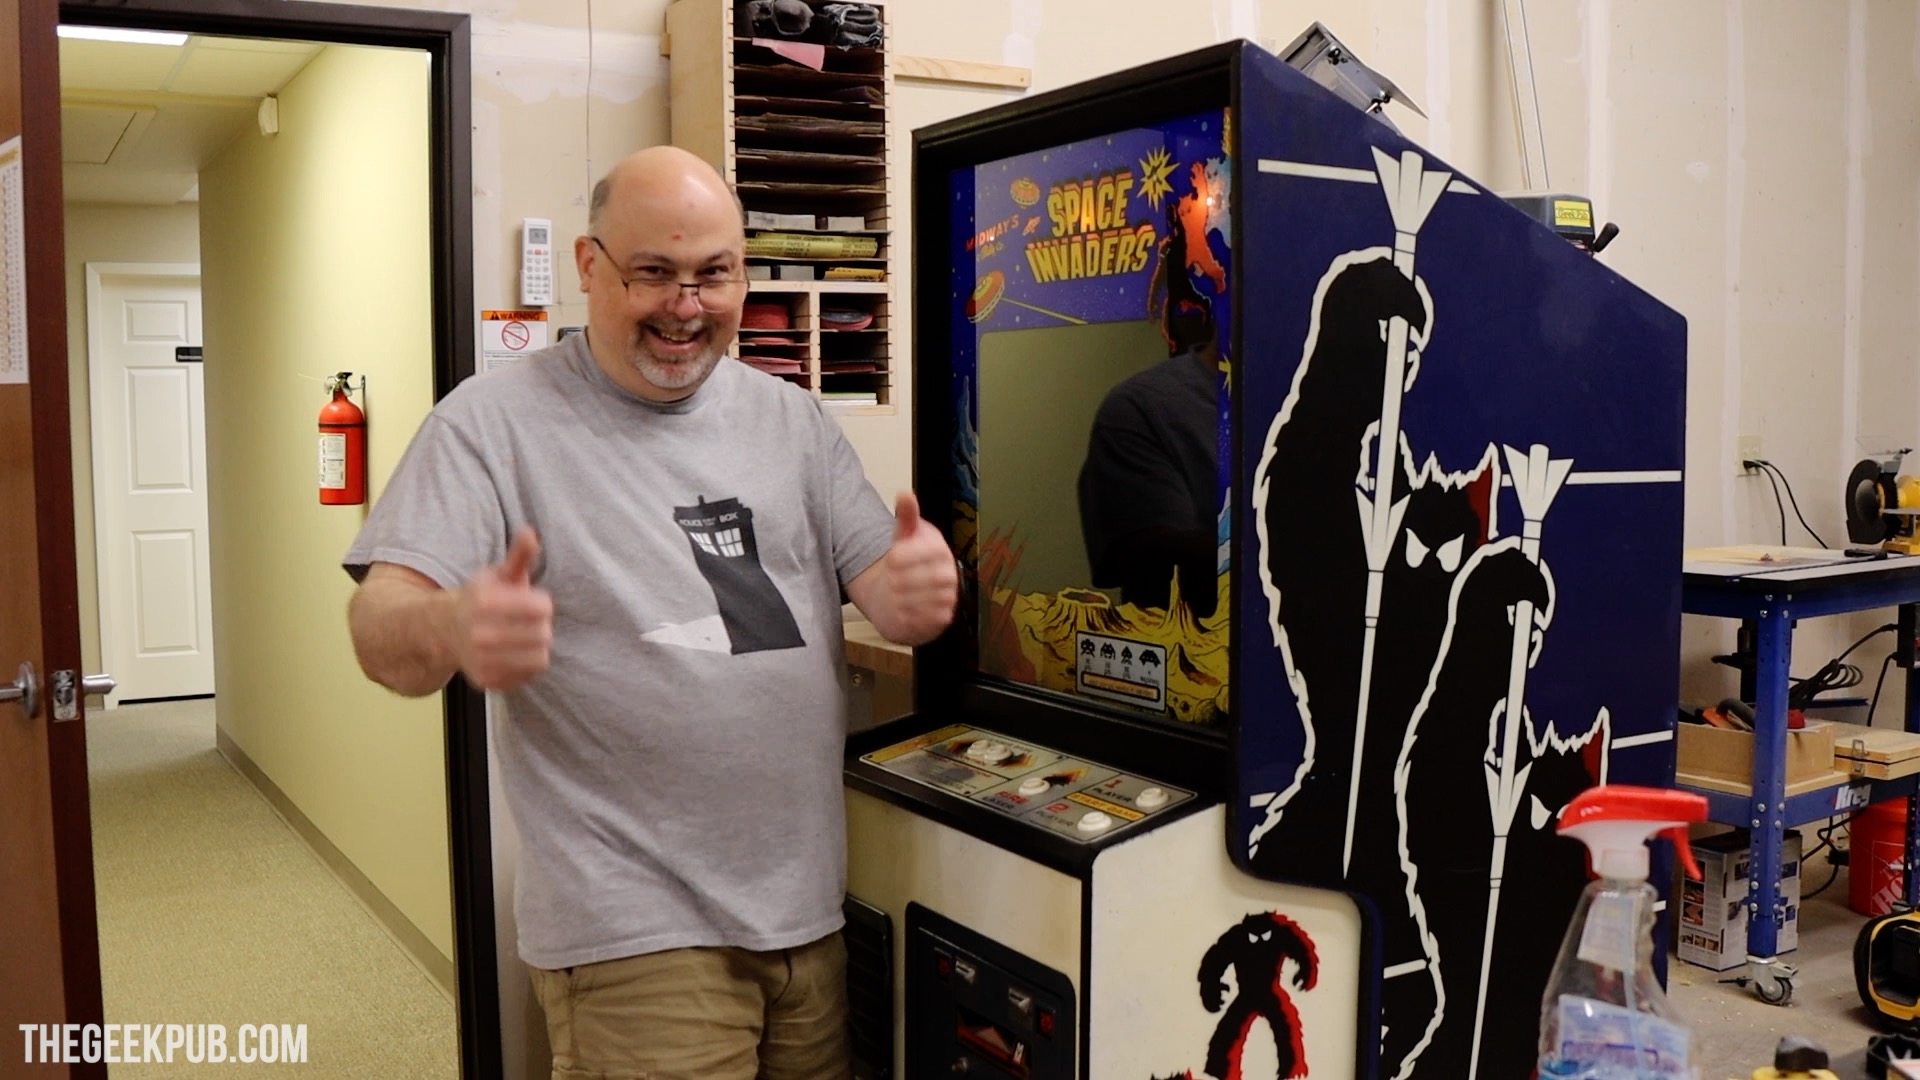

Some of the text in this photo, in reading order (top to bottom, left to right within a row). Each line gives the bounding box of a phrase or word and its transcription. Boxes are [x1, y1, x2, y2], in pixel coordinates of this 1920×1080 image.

[1047, 170, 1134, 237] SPACE
[966, 214, 1019, 252] MIDWAY'S
[1025, 225, 1156, 283] INVADERS
[500, 311, 540, 321] WARNING
[719, 511, 739, 523] BOX
[1834, 783, 1872, 811] Kreg
